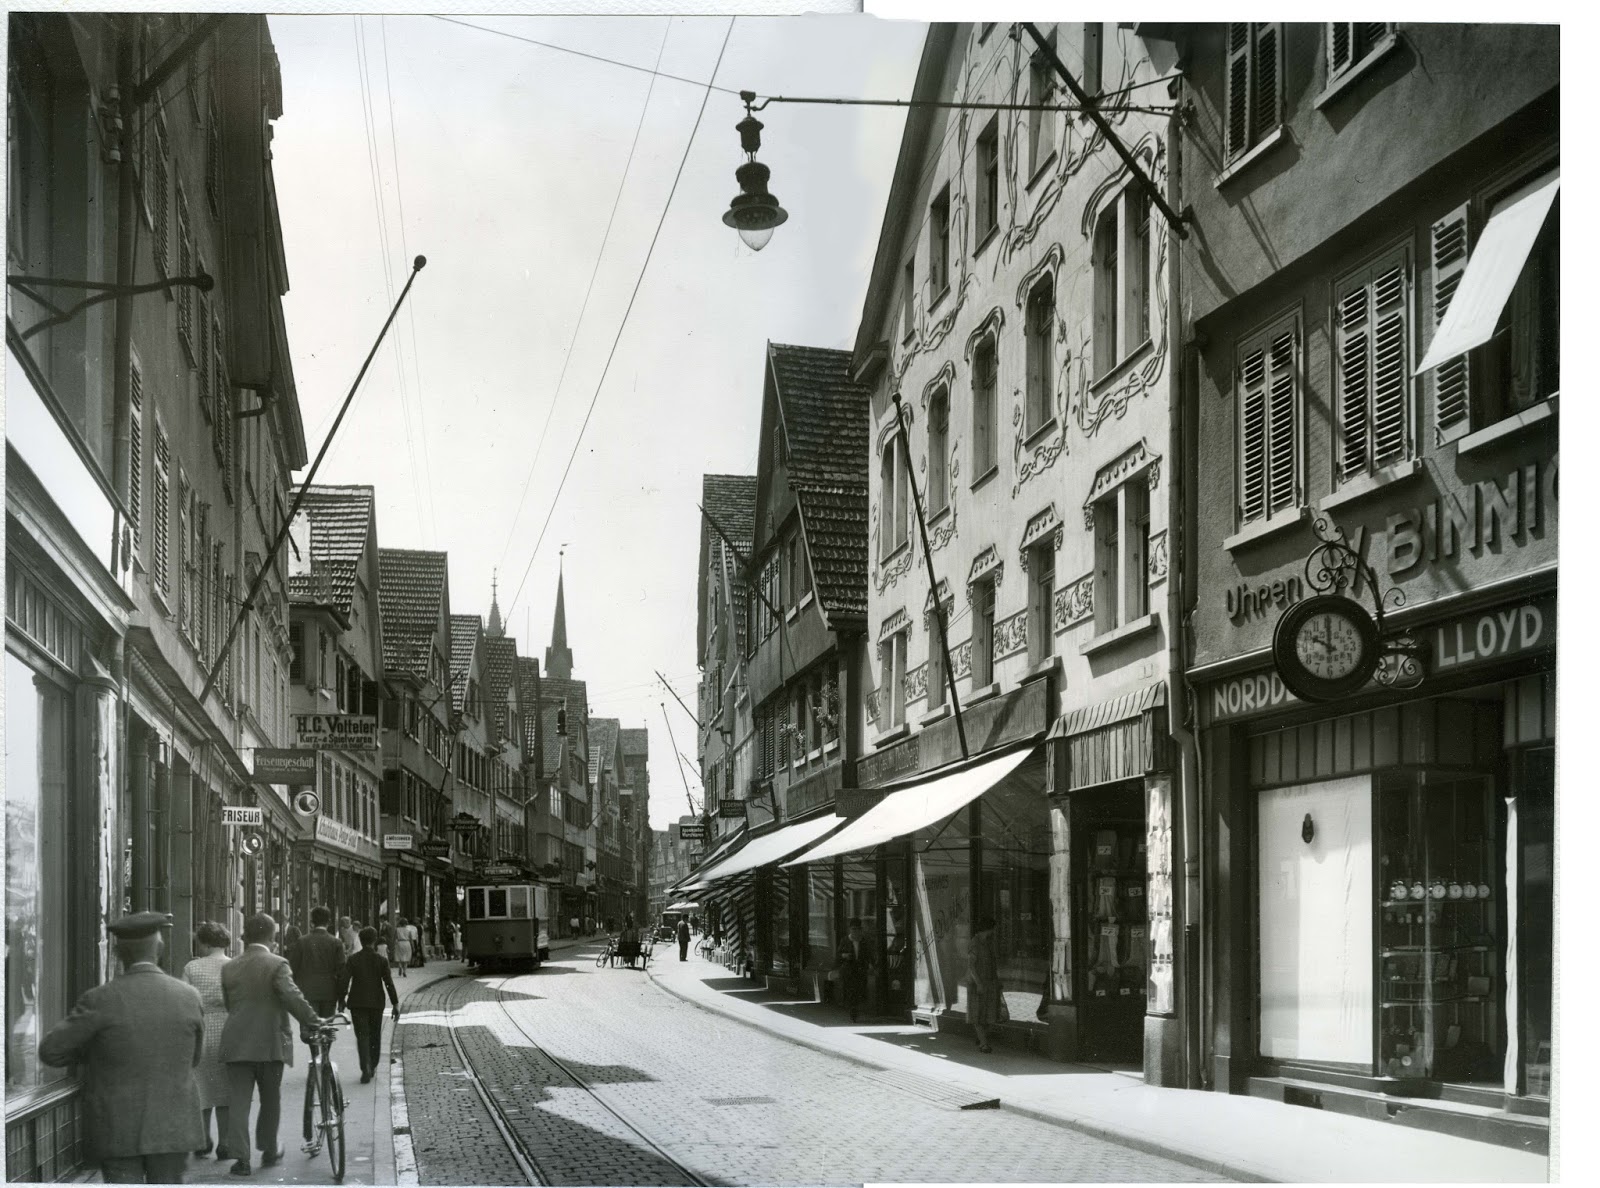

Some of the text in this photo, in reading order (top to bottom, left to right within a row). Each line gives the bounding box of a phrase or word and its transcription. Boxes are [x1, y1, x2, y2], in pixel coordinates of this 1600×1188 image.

[1438, 604, 1543, 667] LLOYD
[1350, 641, 1356, 651] 3
[1305, 654, 1312, 664] 8
[1314, 662, 1321, 674] 7
[1327, 665, 1333, 676] 6
[328, 733, 373, 744] Spielwaren
[222, 810, 260, 823] FRISEUR
